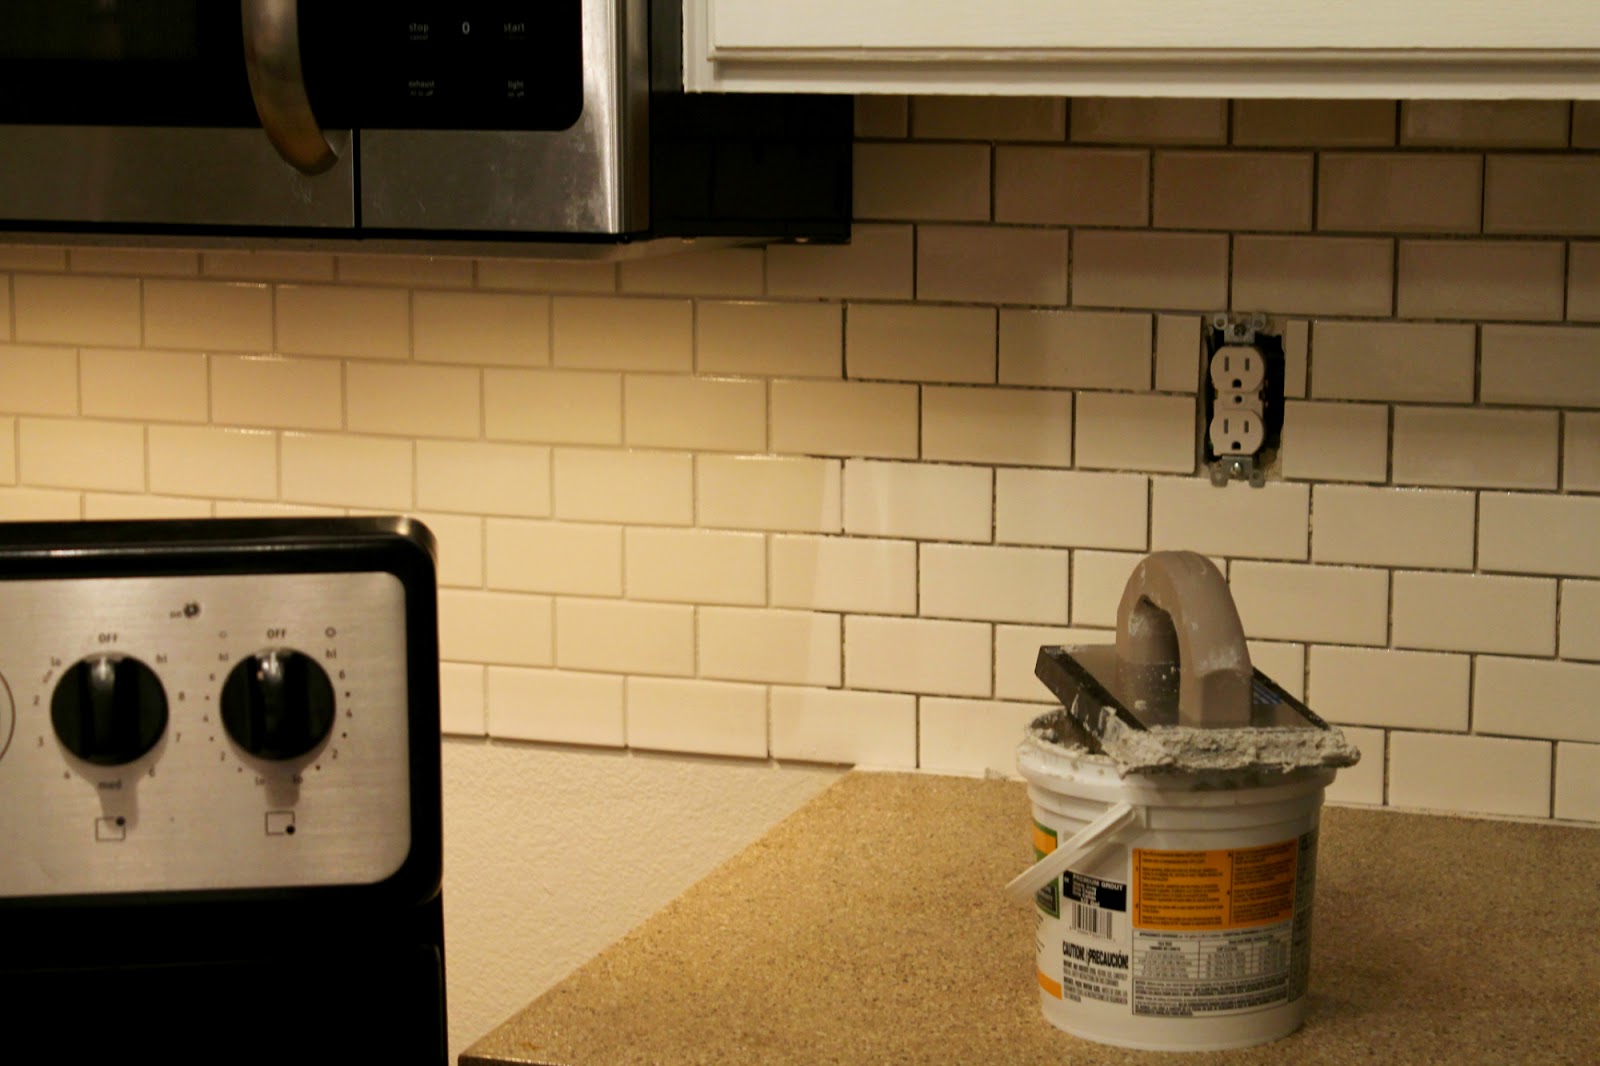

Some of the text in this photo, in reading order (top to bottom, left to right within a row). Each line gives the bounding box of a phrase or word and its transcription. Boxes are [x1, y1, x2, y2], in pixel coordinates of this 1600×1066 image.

[409, 22, 429, 34] stop
[462, 21, 470, 35] 0
[503, 22, 525, 33] start
[98, 633, 119, 643] OFF
[267, 629, 287, 639] OFF
[1101, 881, 1123, 891] GROUT
